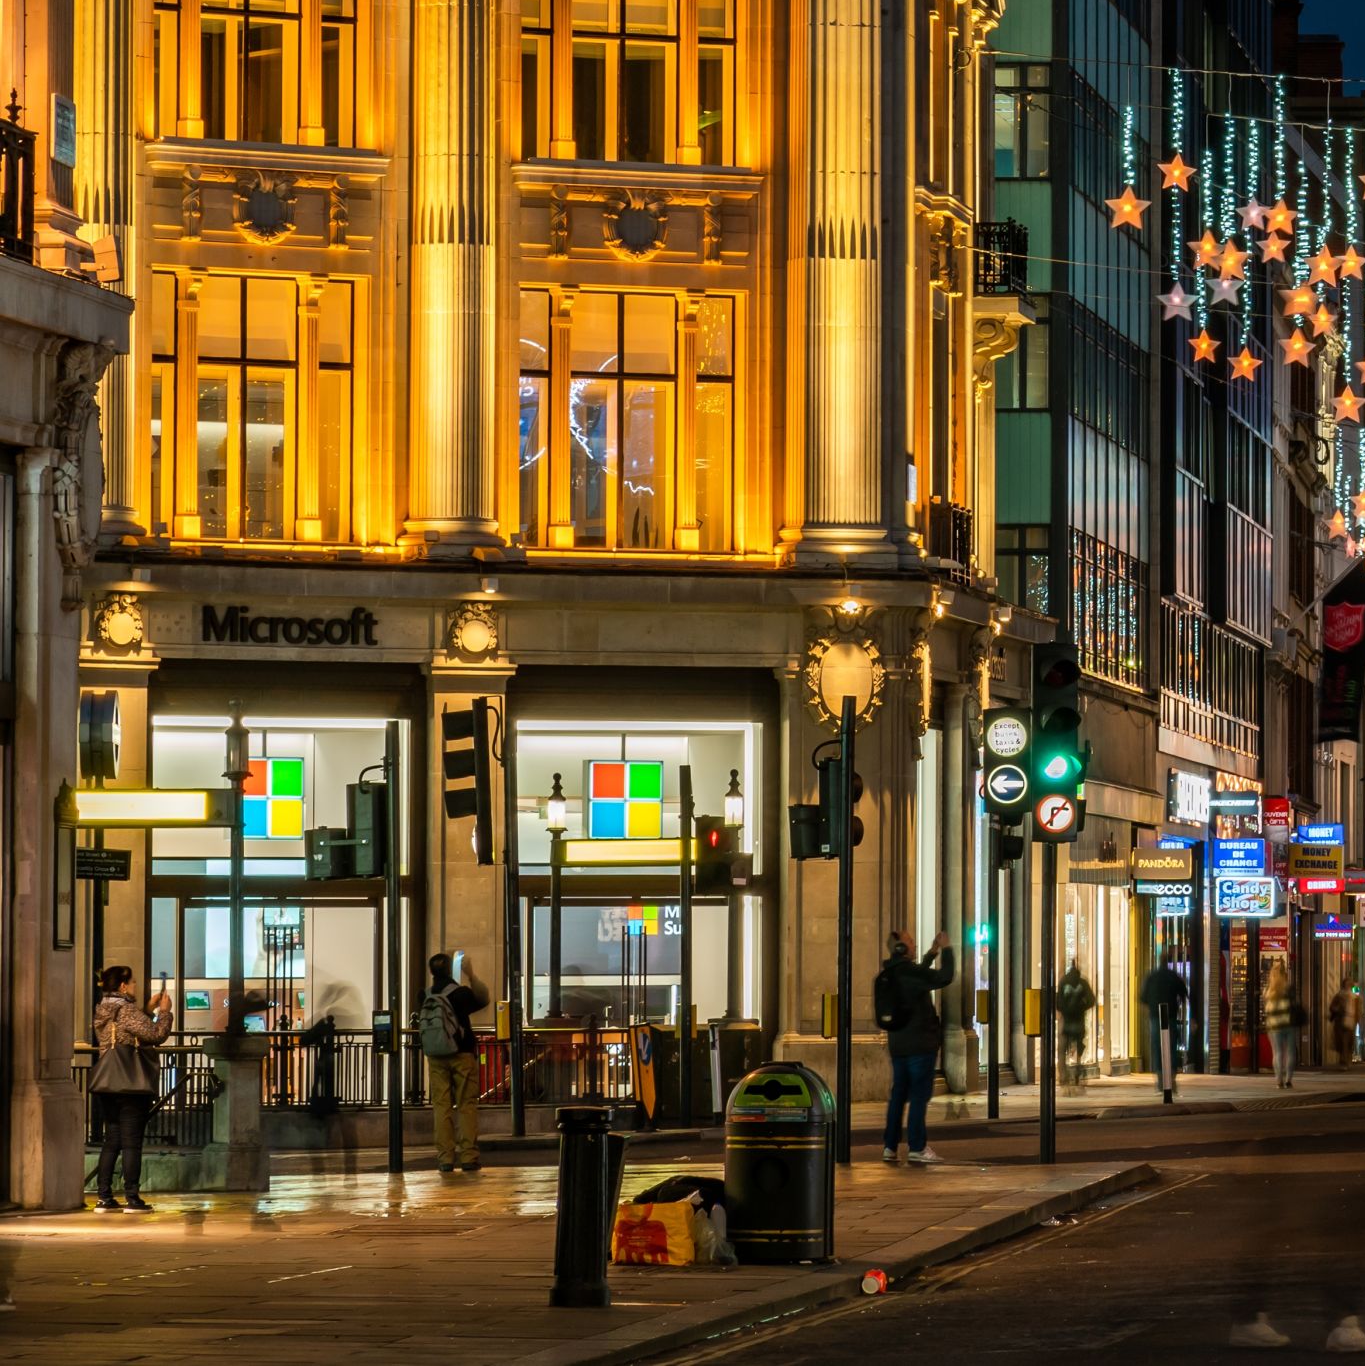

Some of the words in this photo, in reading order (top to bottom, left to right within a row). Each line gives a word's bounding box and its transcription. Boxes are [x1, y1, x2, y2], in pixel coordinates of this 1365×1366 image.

[202, 605, 379, 647] Microsoft
[1308, 827, 1334, 838] MONEY
[1232, 850, 1245, 858] DE
[1302, 847, 1331, 856] MONEY
[1138, 857, 1185, 868] PANDORA
[1295, 859, 1338, 869] EXCHANGE
[1157, 884, 1193, 895] ecco
[1222, 881, 1269, 896] Candy
[1307, 880, 1337, 890] DRINKS
[1222, 896, 1259, 911] Shop
